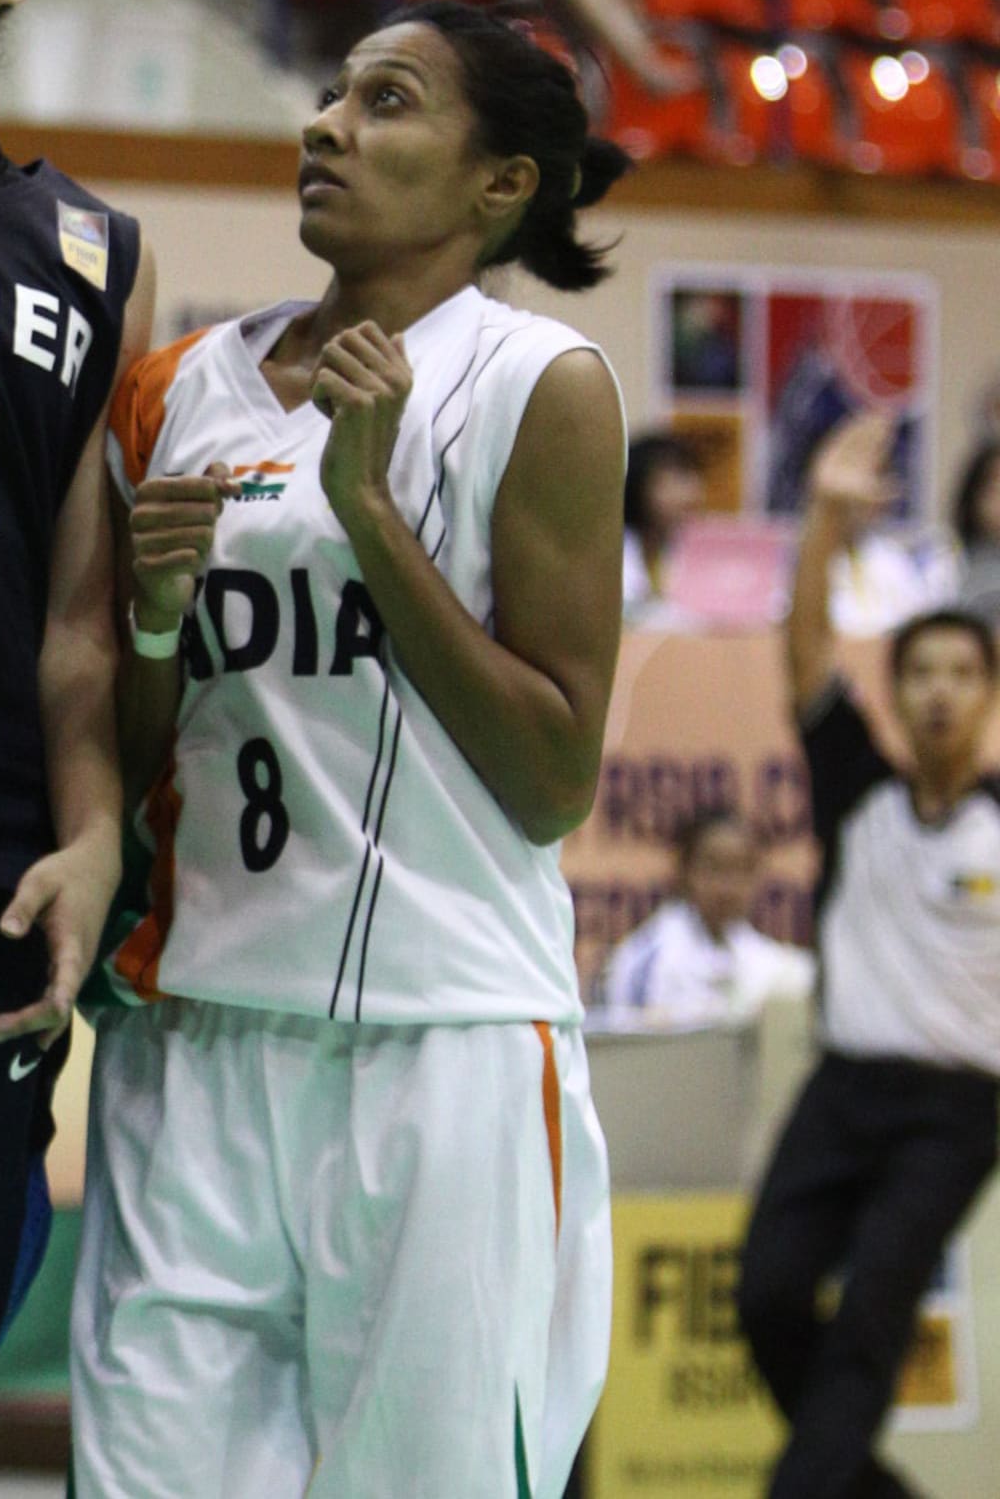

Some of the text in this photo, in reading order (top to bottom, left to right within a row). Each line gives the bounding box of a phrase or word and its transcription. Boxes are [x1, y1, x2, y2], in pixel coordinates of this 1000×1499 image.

[181, 565, 386, 682] NDIA
[237, 736, 291, 875] 8
[636, 1244, 742, 1352] FIB
